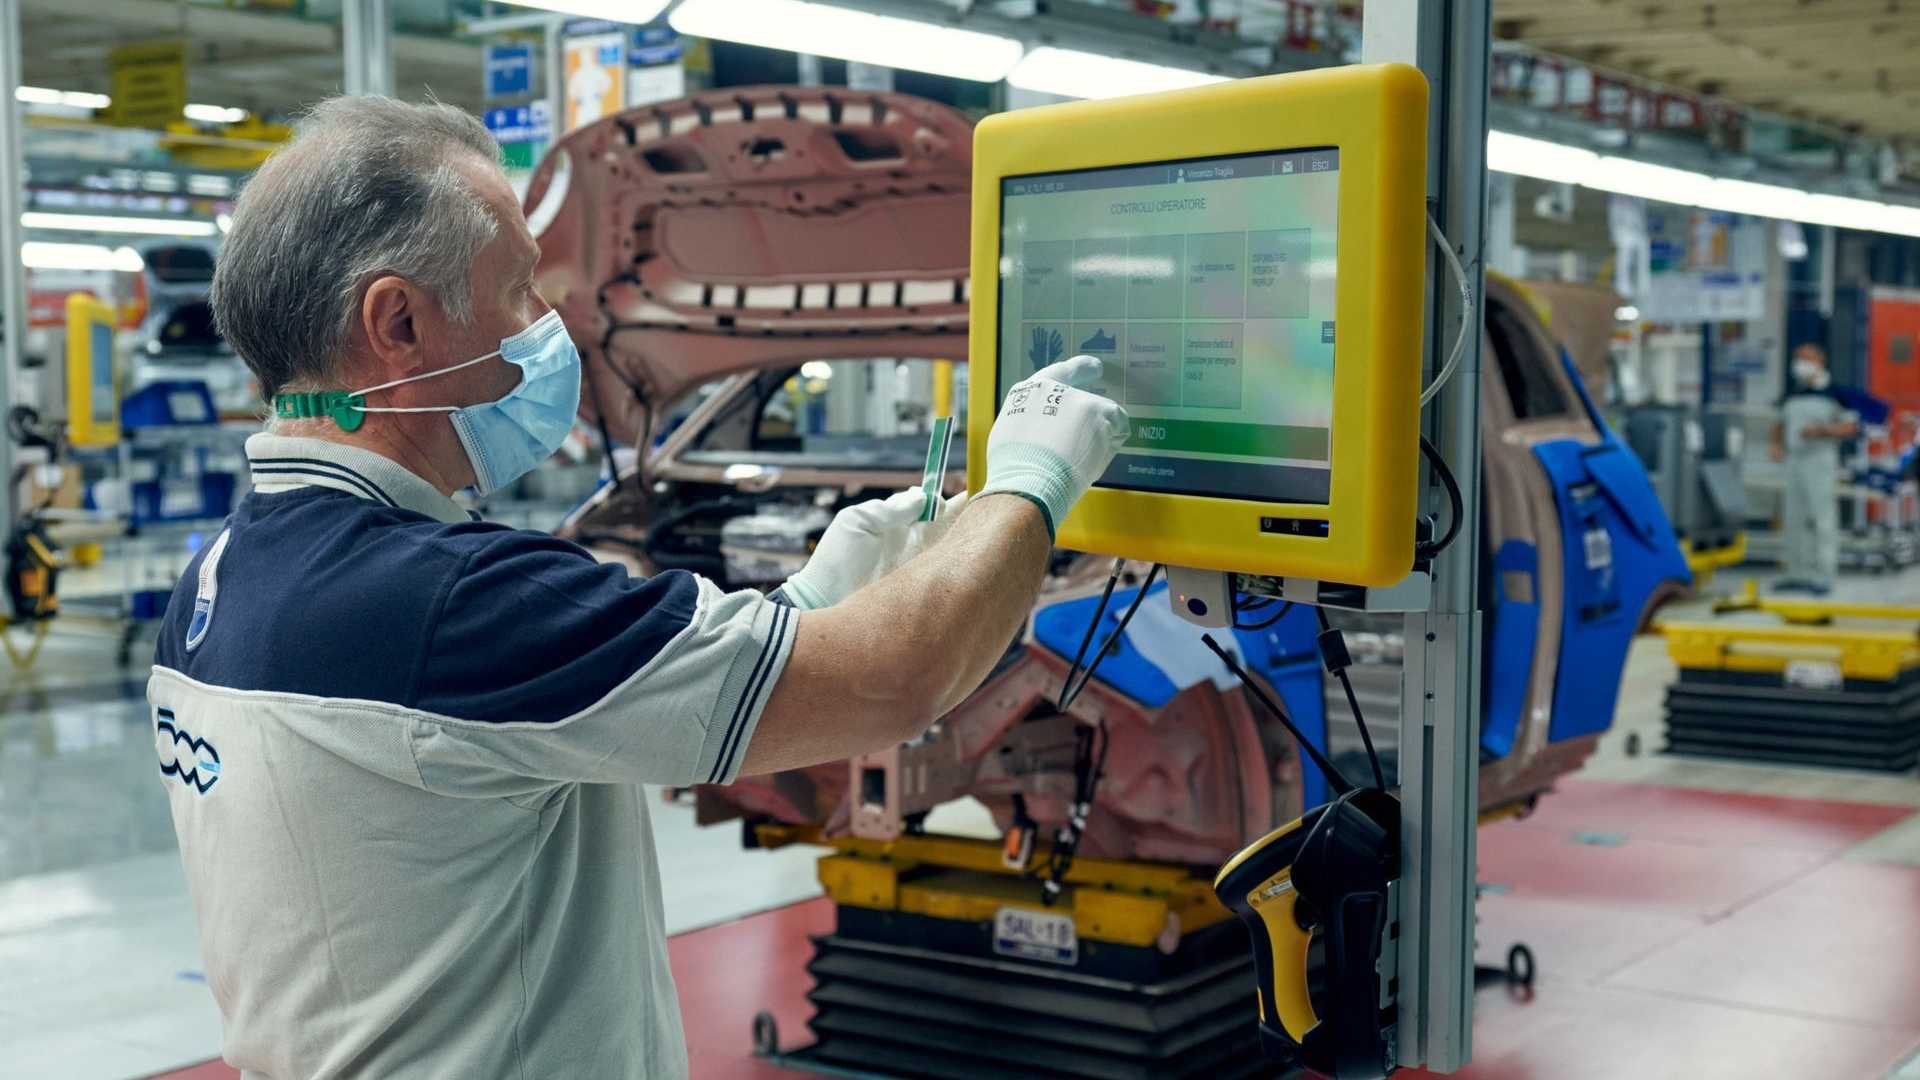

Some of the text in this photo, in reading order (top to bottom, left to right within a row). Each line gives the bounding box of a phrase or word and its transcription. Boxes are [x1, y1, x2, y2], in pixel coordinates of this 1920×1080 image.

[1312, 160, 1329, 171] ESCI
[1110, 198, 1207, 214] CONTROLLI OPERATORE
[1047, 394, 1062, 405] CE
[1138, 426, 1166, 440] INIZIO
